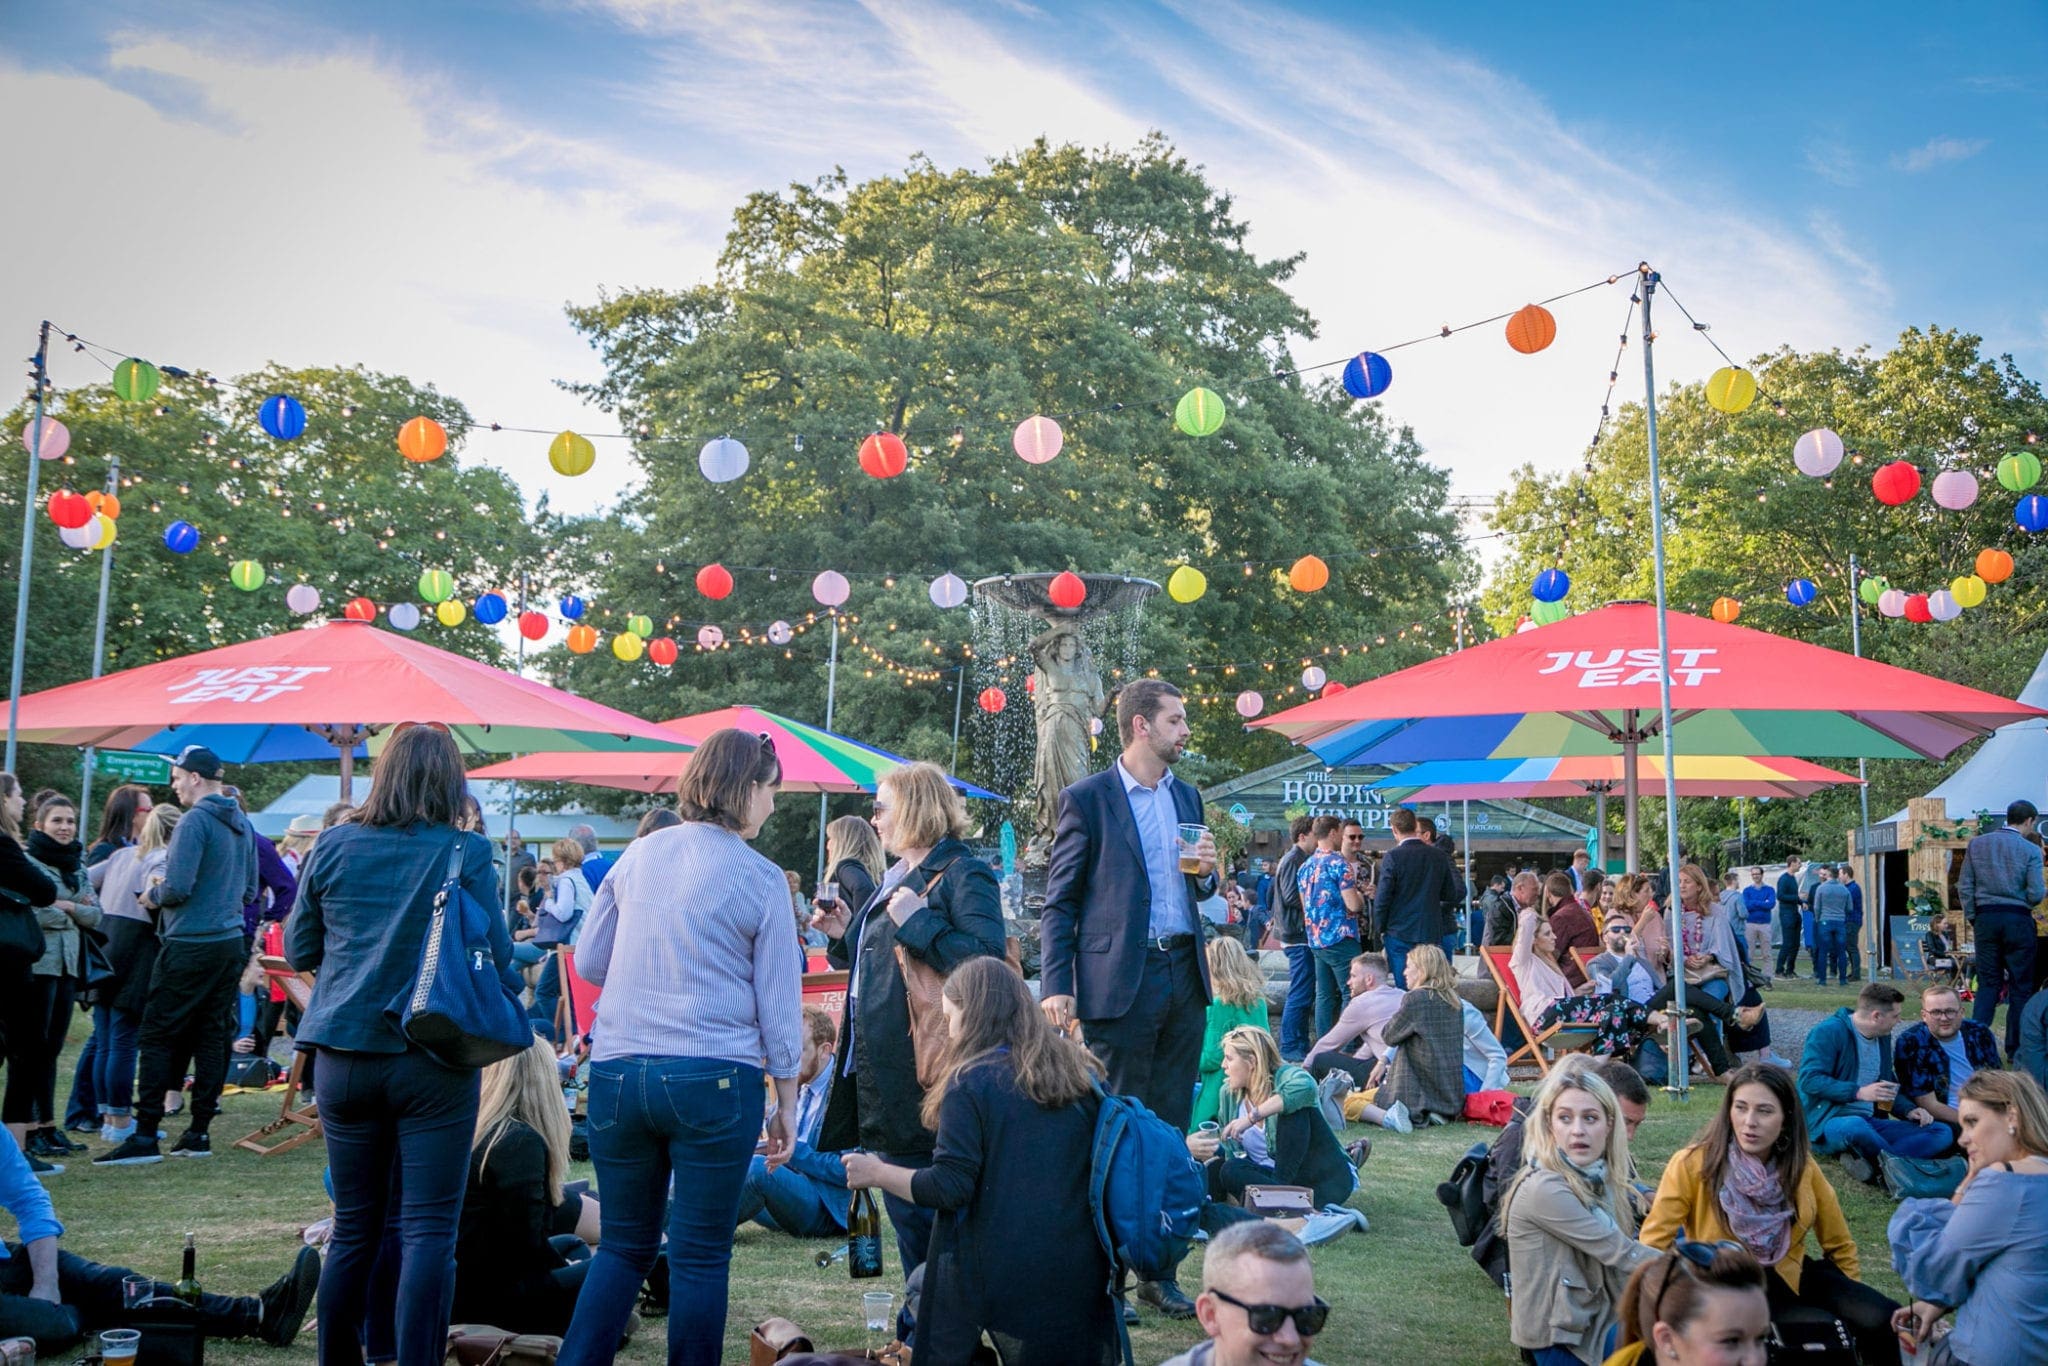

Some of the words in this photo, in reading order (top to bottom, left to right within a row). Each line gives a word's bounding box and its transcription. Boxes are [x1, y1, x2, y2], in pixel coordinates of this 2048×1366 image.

[1538, 648, 1718, 675] JUST
[166, 666, 332, 691] JUST
[1577, 667, 1721, 688] EAT
[168, 684, 304, 704] EAT
[1306, 771, 1332, 782] THE
[1282, 780, 1386, 804] HOPPIN
[1308, 805, 1395, 829] JNIPE
